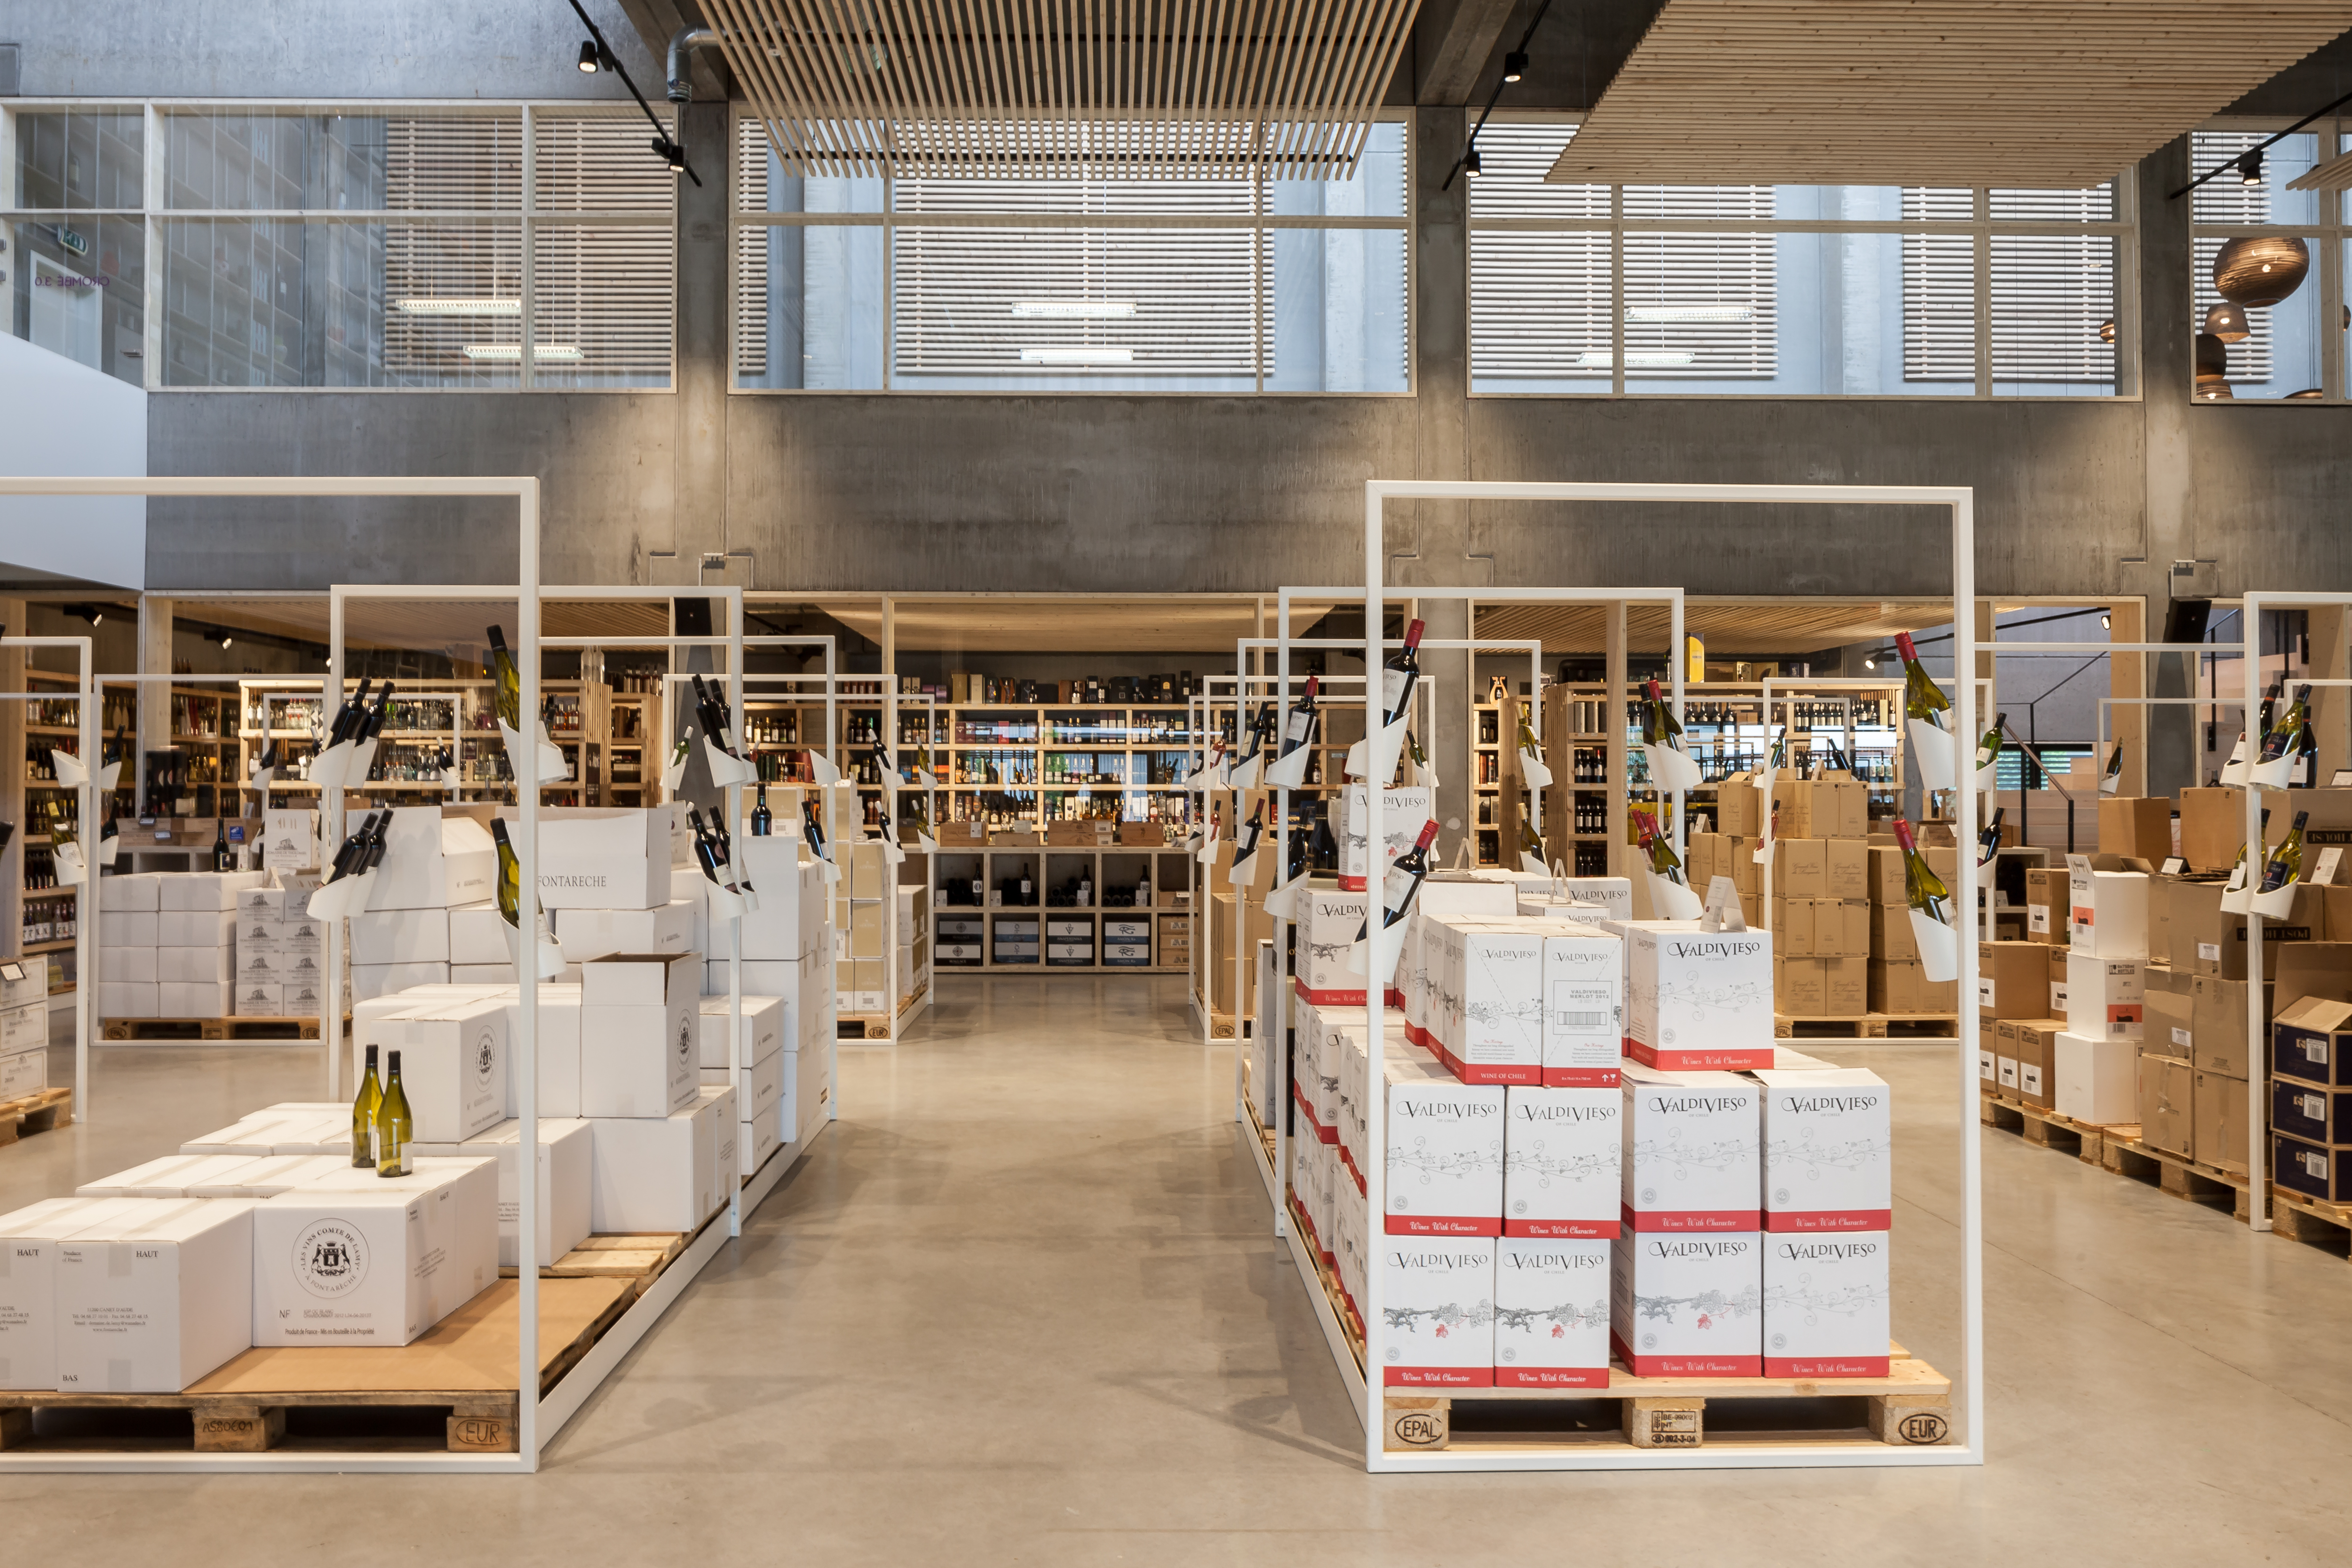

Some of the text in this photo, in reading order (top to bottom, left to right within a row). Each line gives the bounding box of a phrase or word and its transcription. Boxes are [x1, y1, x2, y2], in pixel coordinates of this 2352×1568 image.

[1481, 949, 1536, 959] VALDIVIESO
[1552, 952, 1607, 962] VALDIVIESO
[1667, 942, 1760, 958] VALDIVIESO
[1681, 1056, 1751, 1065] Wines With Character
[1396, 1101, 1497, 1119] VALDIVIESO
[1514, 1105, 1616, 1122] VALDIVIESO
[1648, 1097, 1746, 1114] VALDIVIESO
[1781, 1097, 1876, 1114] VALDIVIESO
[1410, 1221, 1478, 1232] Wines With Character
[1529, 1225, 1597, 1234] Wines With Character
[1661, 1217, 1736, 1227] Wines With Character
[1795, 1217, 1867, 1227] Wines With Character
[302, 1234, 316, 1250] VINS
[317, 1227, 344, 1236] COMTE
[345, 1233, 355, 1244] DE
[352, 1243, 361, 1267] LAMY
[1648, 1241, 1747, 1258] VALDIVIESO
[1778, 1243, 1876, 1261] VALDIVIESO
[1387, 1252, 1488, 1270] VALDIVIESO
[1503, 1253, 1604, 1270] VALDIVIESO
[310, 1274, 357, 1292] FONTARÈCHE
[279, 1309, 291, 1318] NF
[1661, 1362, 1737, 1372] Wines With Character
[1792, 1364, 1866, 1373] Wines With Character
[1402, 1372, 1470, 1382] Wines With Character
[1518, 1373, 1586, 1383] Wines With Character
[465, 1422, 500, 1443] EUR
[1403, 1420, 1438, 1437] EPAL
[1909, 1419, 1937, 1438] EUR
